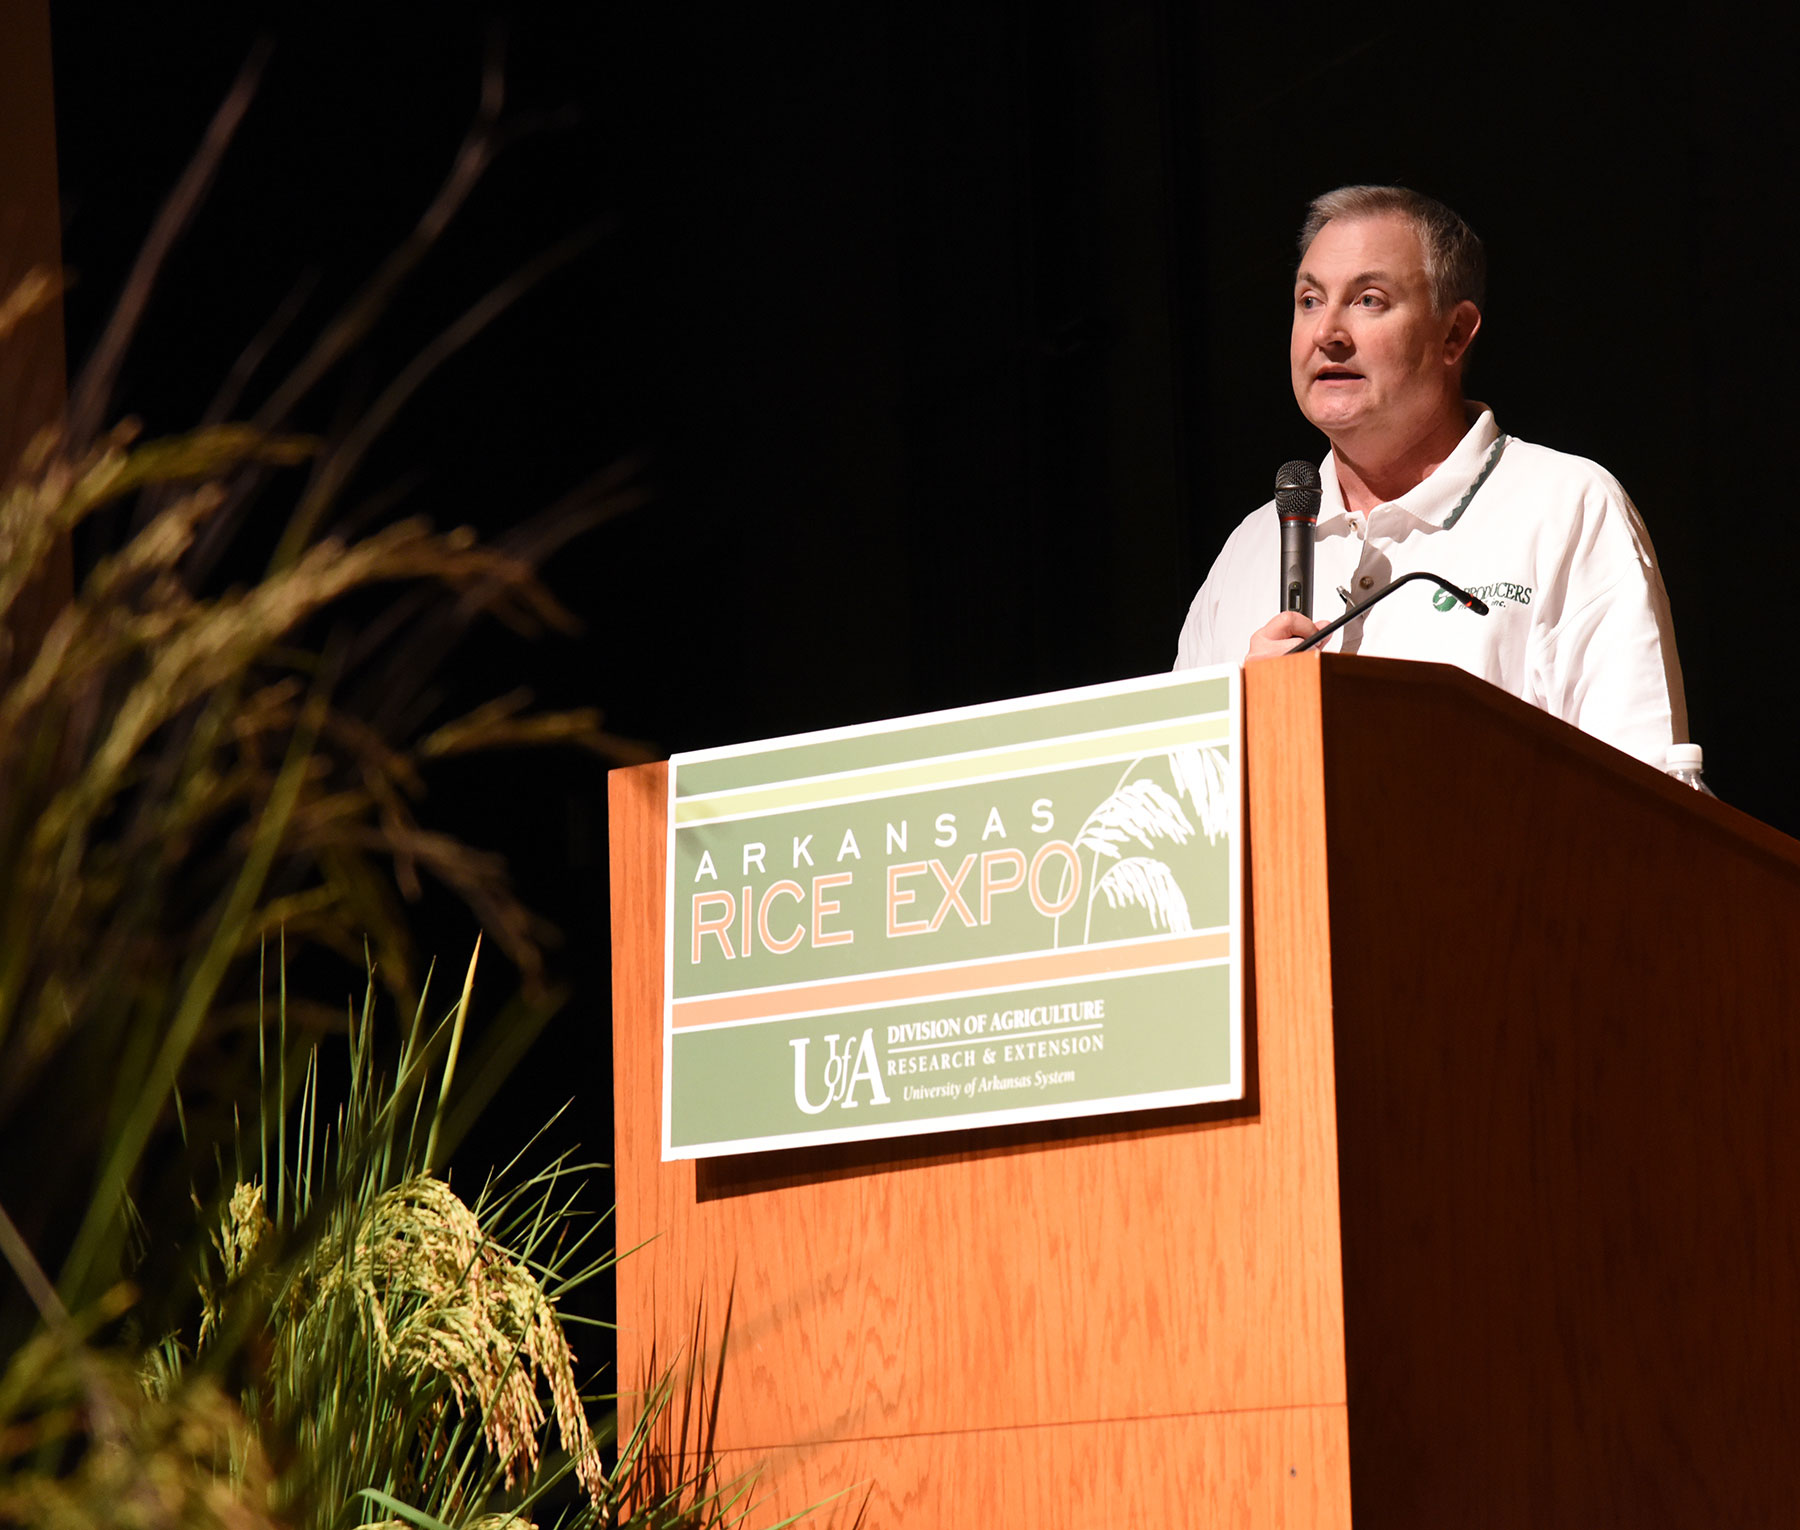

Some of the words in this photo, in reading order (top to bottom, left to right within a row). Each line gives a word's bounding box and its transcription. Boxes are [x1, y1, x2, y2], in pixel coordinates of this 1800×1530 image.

[694, 798, 1055, 882] ARKANSAS
[691, 872, 853, 965] RICE
[886, 839, 1082, 938] EXPO
[887, 1017, 960, 1044] DIVISION
[964, 1014, 987, 1034] OF
[990, 999, 1105, 1031] AGRICULTURE
[887, 1048, 976, 1076] RESEARCH
[982, 1047, 996, 1064] &
[1004, 1034, 1105, 1062] EXTENSION
[903, 1082, 961, 1101] University
[964, 1077, 978, 1098] of
[978, 1074, 1032, 1093] Arkansas
[1034, 1068, 1075, 1090] System
